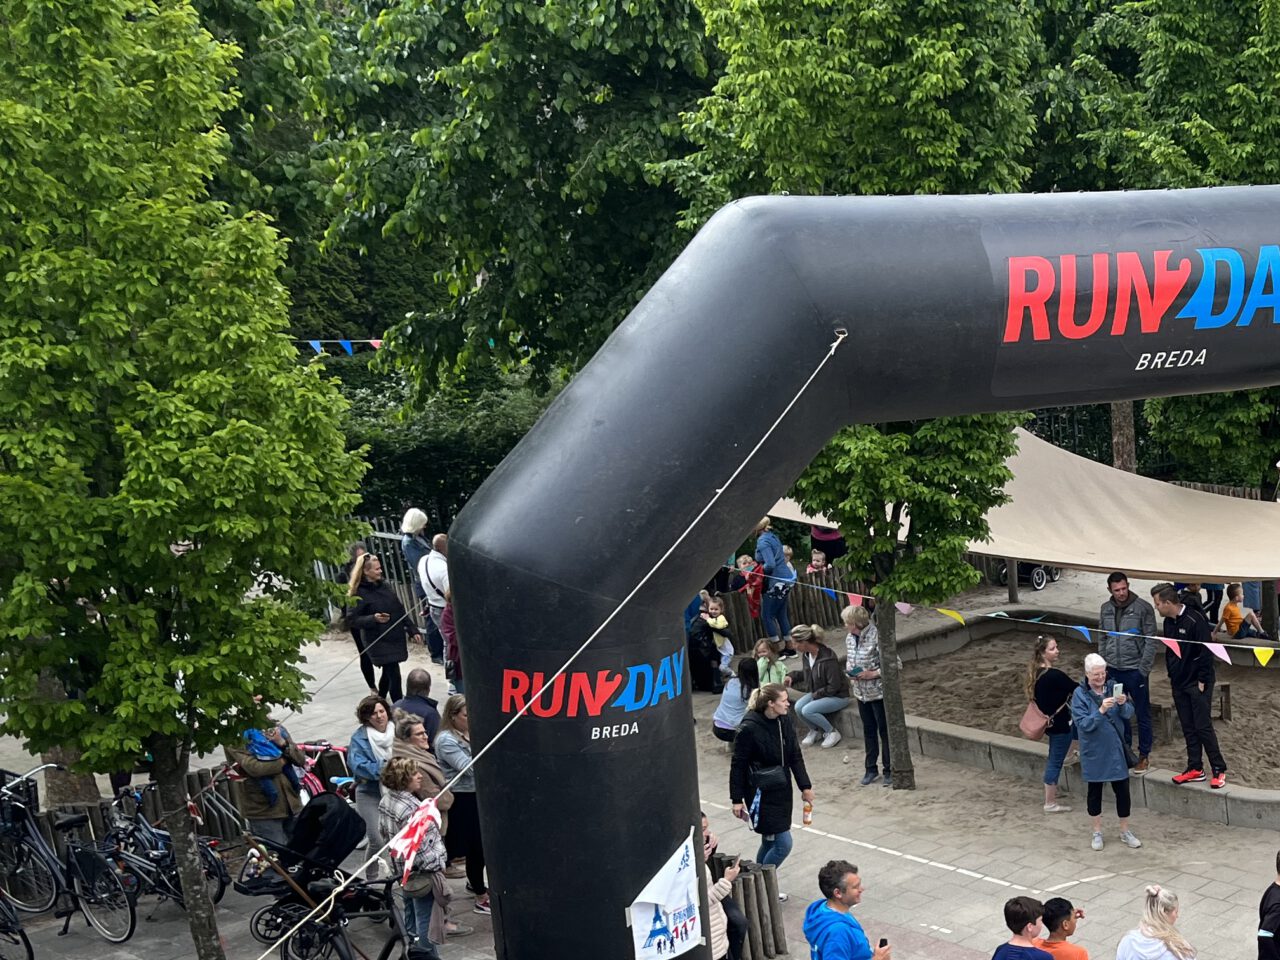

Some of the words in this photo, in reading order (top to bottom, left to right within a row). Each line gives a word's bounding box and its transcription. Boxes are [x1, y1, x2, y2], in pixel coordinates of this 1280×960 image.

[1134, 348, 1207, 371] BREDA
[501, 646, 685, 718] RUN2DAY
[591, 721, 640, 740] BREDA
